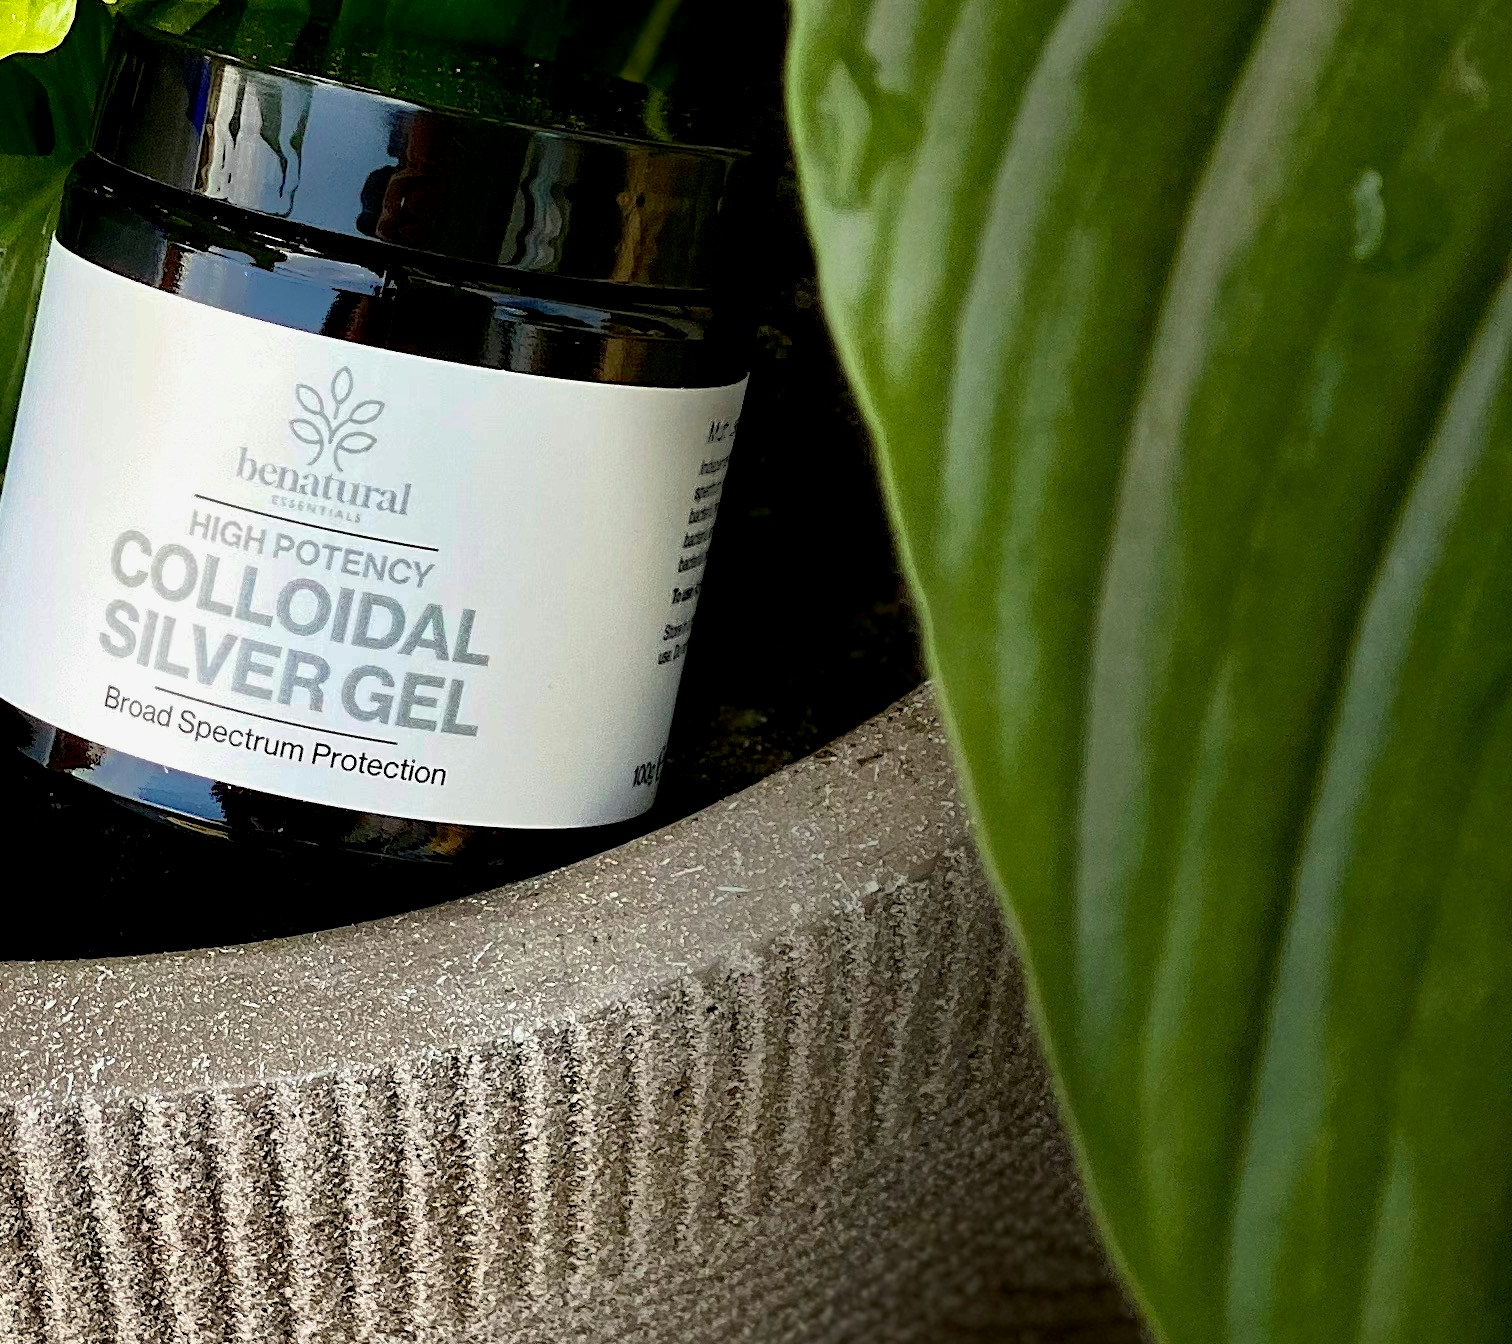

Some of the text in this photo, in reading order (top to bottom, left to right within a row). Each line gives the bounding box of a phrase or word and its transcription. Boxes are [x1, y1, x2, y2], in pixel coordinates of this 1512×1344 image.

[236, 446, 412, 516] benatural
[271, 494, 362, 524] ESSENTIALS
[189, 509, 435, 589] HIGH POTENCY
[110, 529, 490, 666] COLLOIDAL
[98, 598, 478, 739] SILVER GEL
[103, 685, 447, 787] Broad Spectrum Protection
